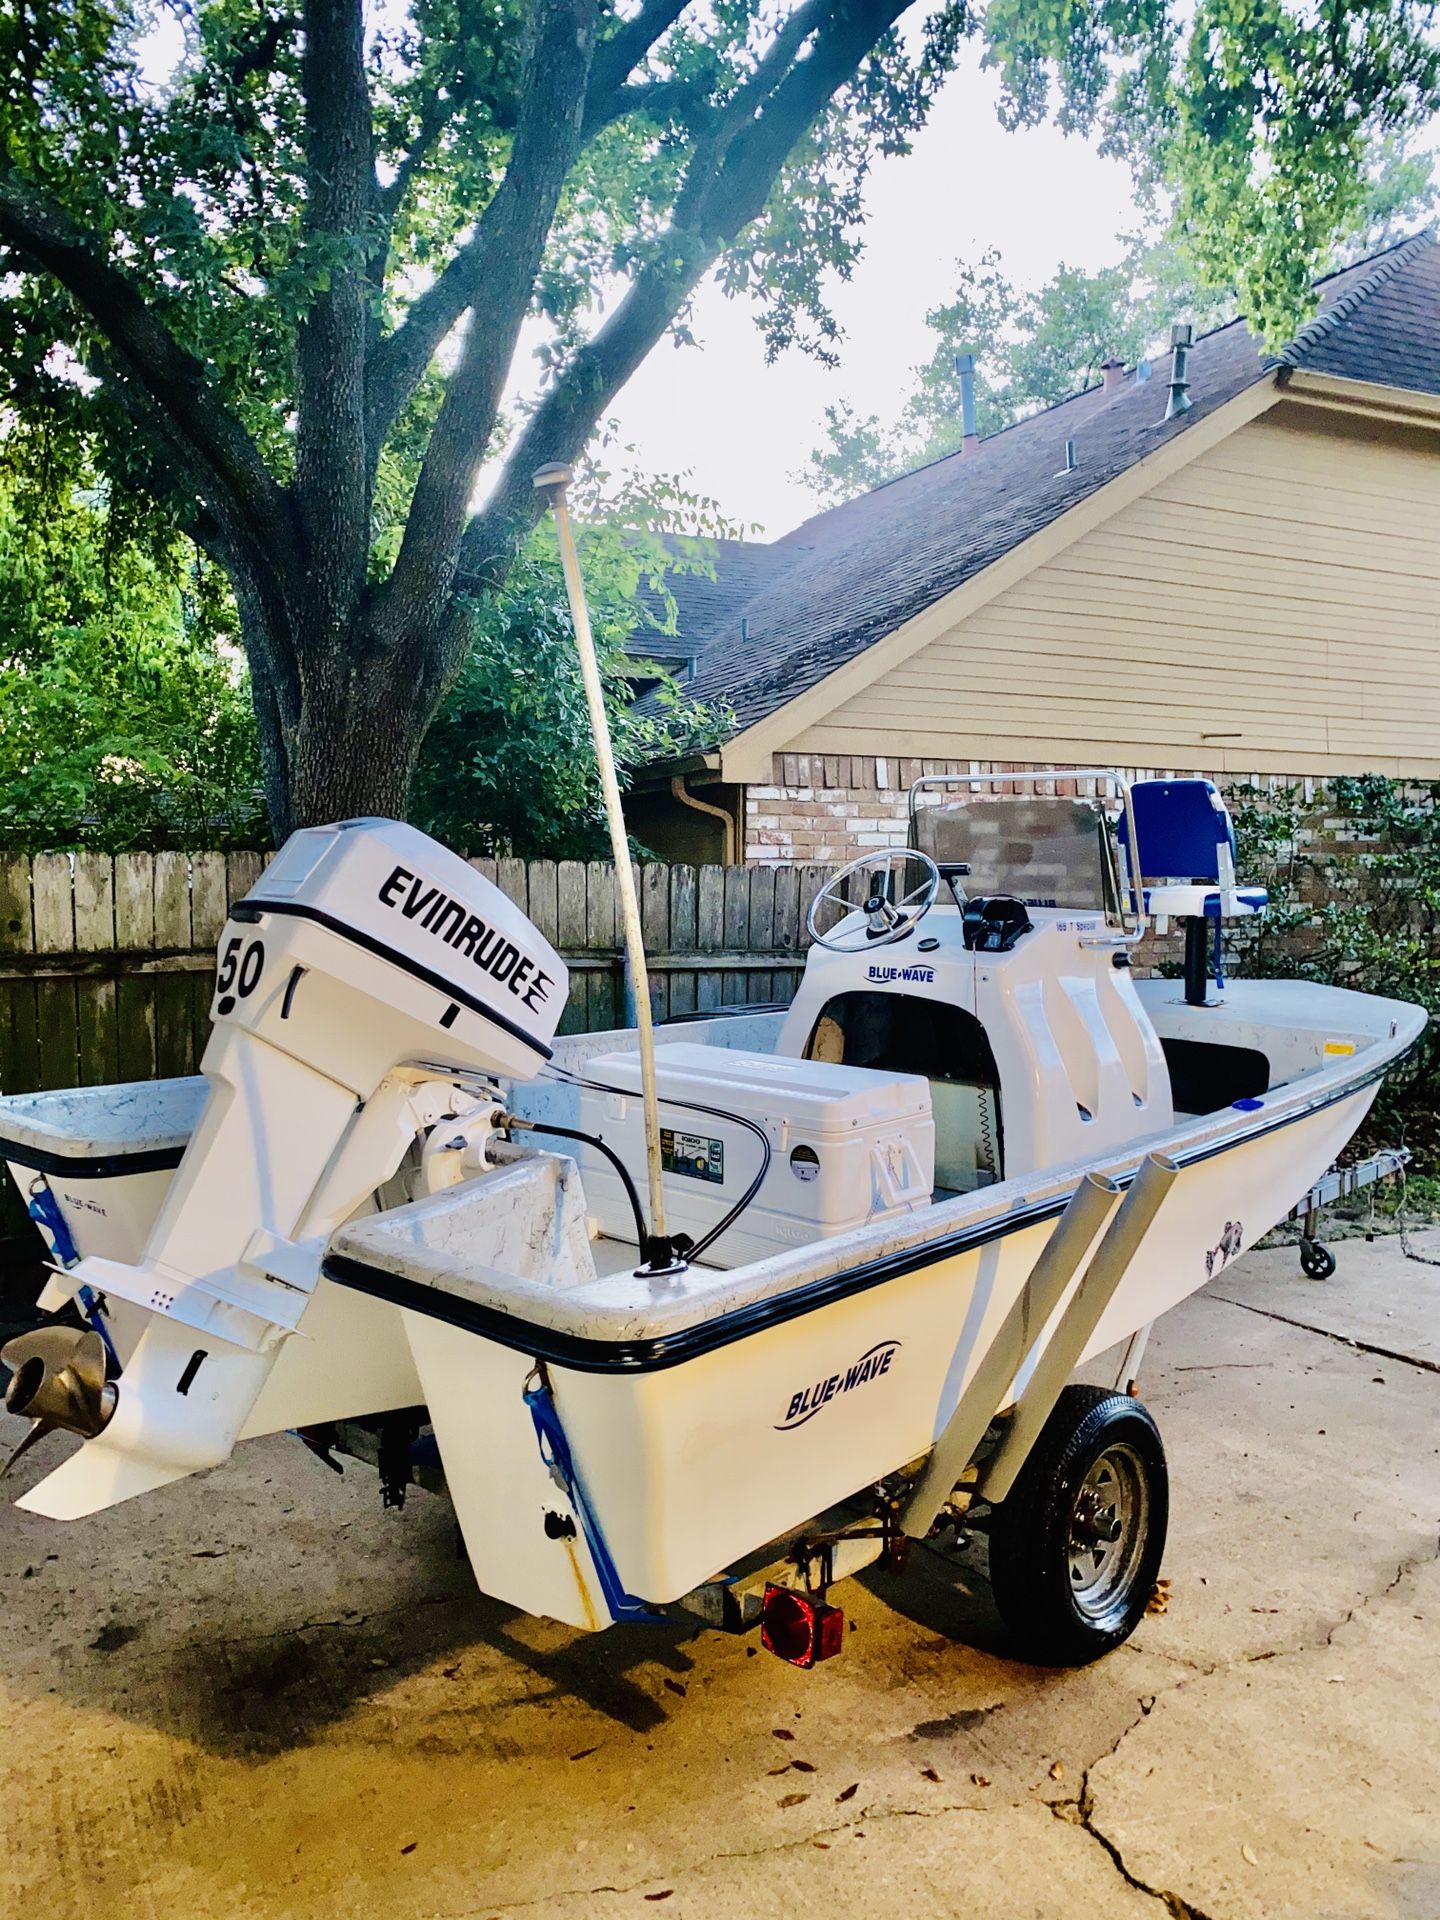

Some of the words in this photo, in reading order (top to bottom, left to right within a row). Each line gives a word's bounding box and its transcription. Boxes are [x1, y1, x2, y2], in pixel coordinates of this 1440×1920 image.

[378, 865, 535, 995] EVINRUDE
[217, 938, 265, 998] 50
[868, 966, 898, 980] BLUE
[901, 968, 934, 983] WAVE
[64, 1193, 84, 1208] BLUE
[86, 1203, 107, 1217] WAVE
[785, 1374, 840, 1422] BLUE
[843, 1347, 896, 1393] WAVE
